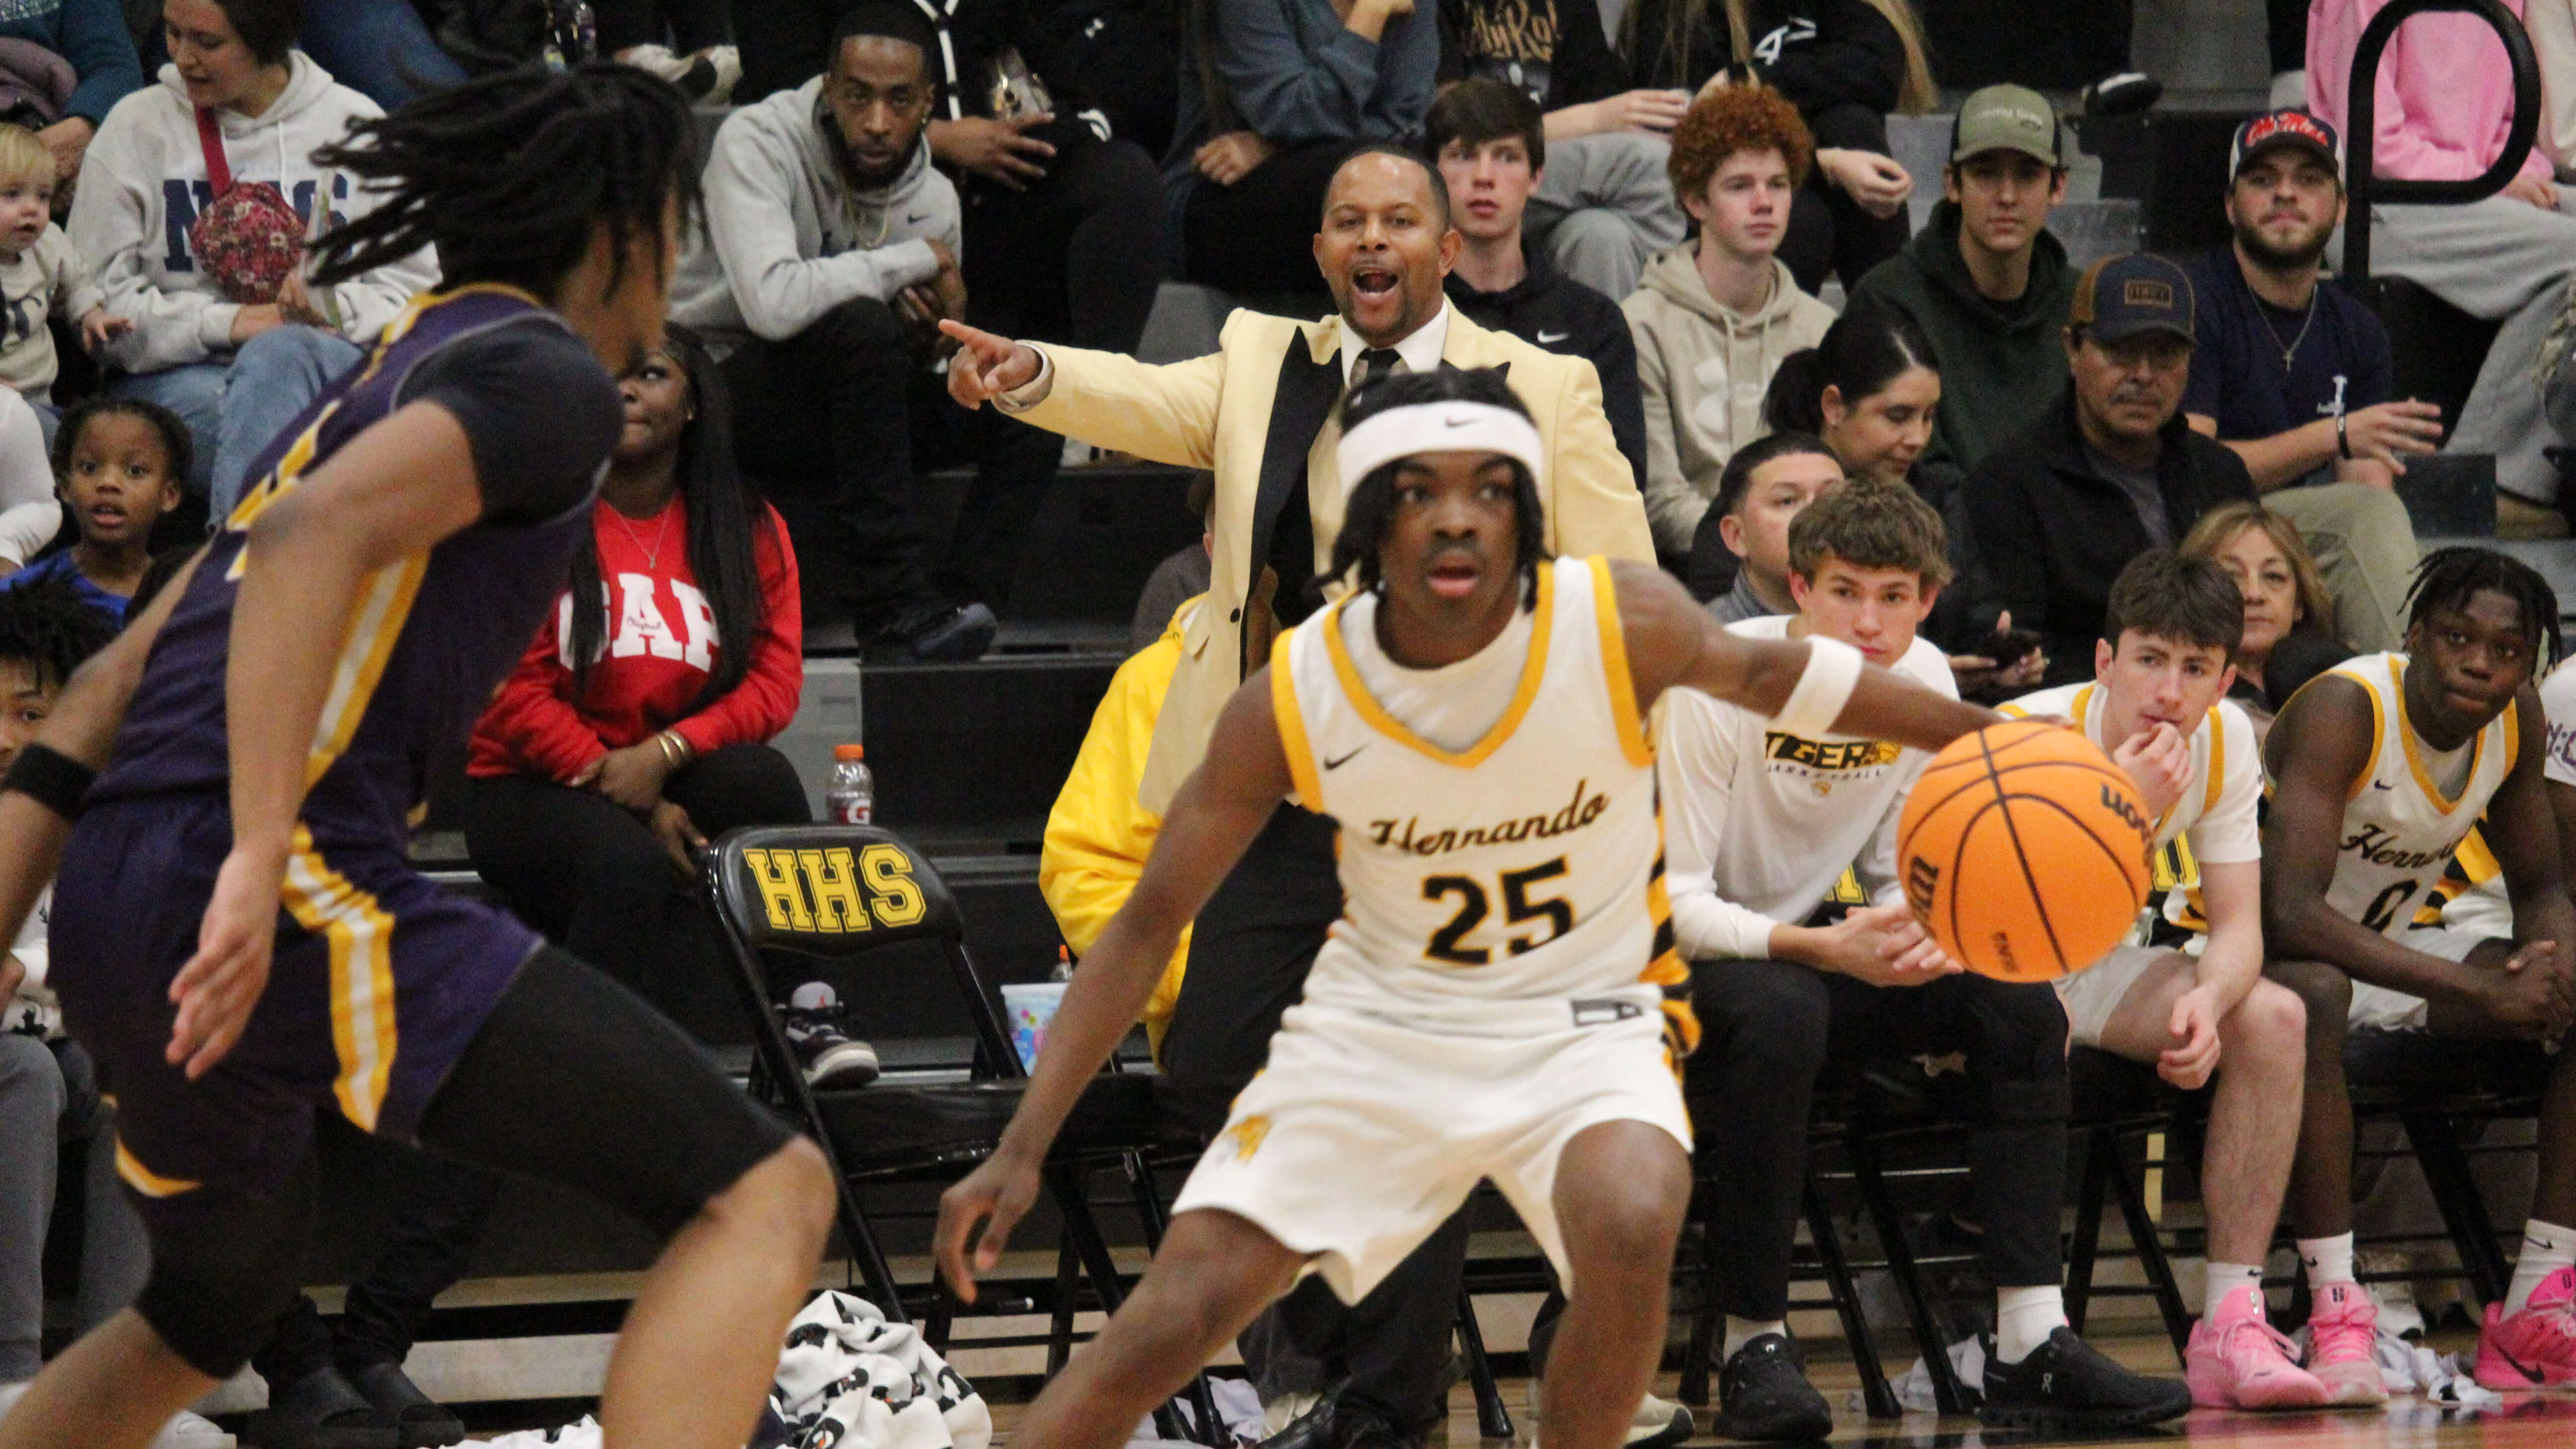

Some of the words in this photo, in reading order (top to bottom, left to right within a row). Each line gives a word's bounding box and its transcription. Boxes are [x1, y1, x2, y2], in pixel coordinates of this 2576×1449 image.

[847, 798, 871, 825] G
[1369, 777, 1611, 856] Hernando
[742, 843, 927, 933] HHS
[1421, 853, 1575, 966] 25
